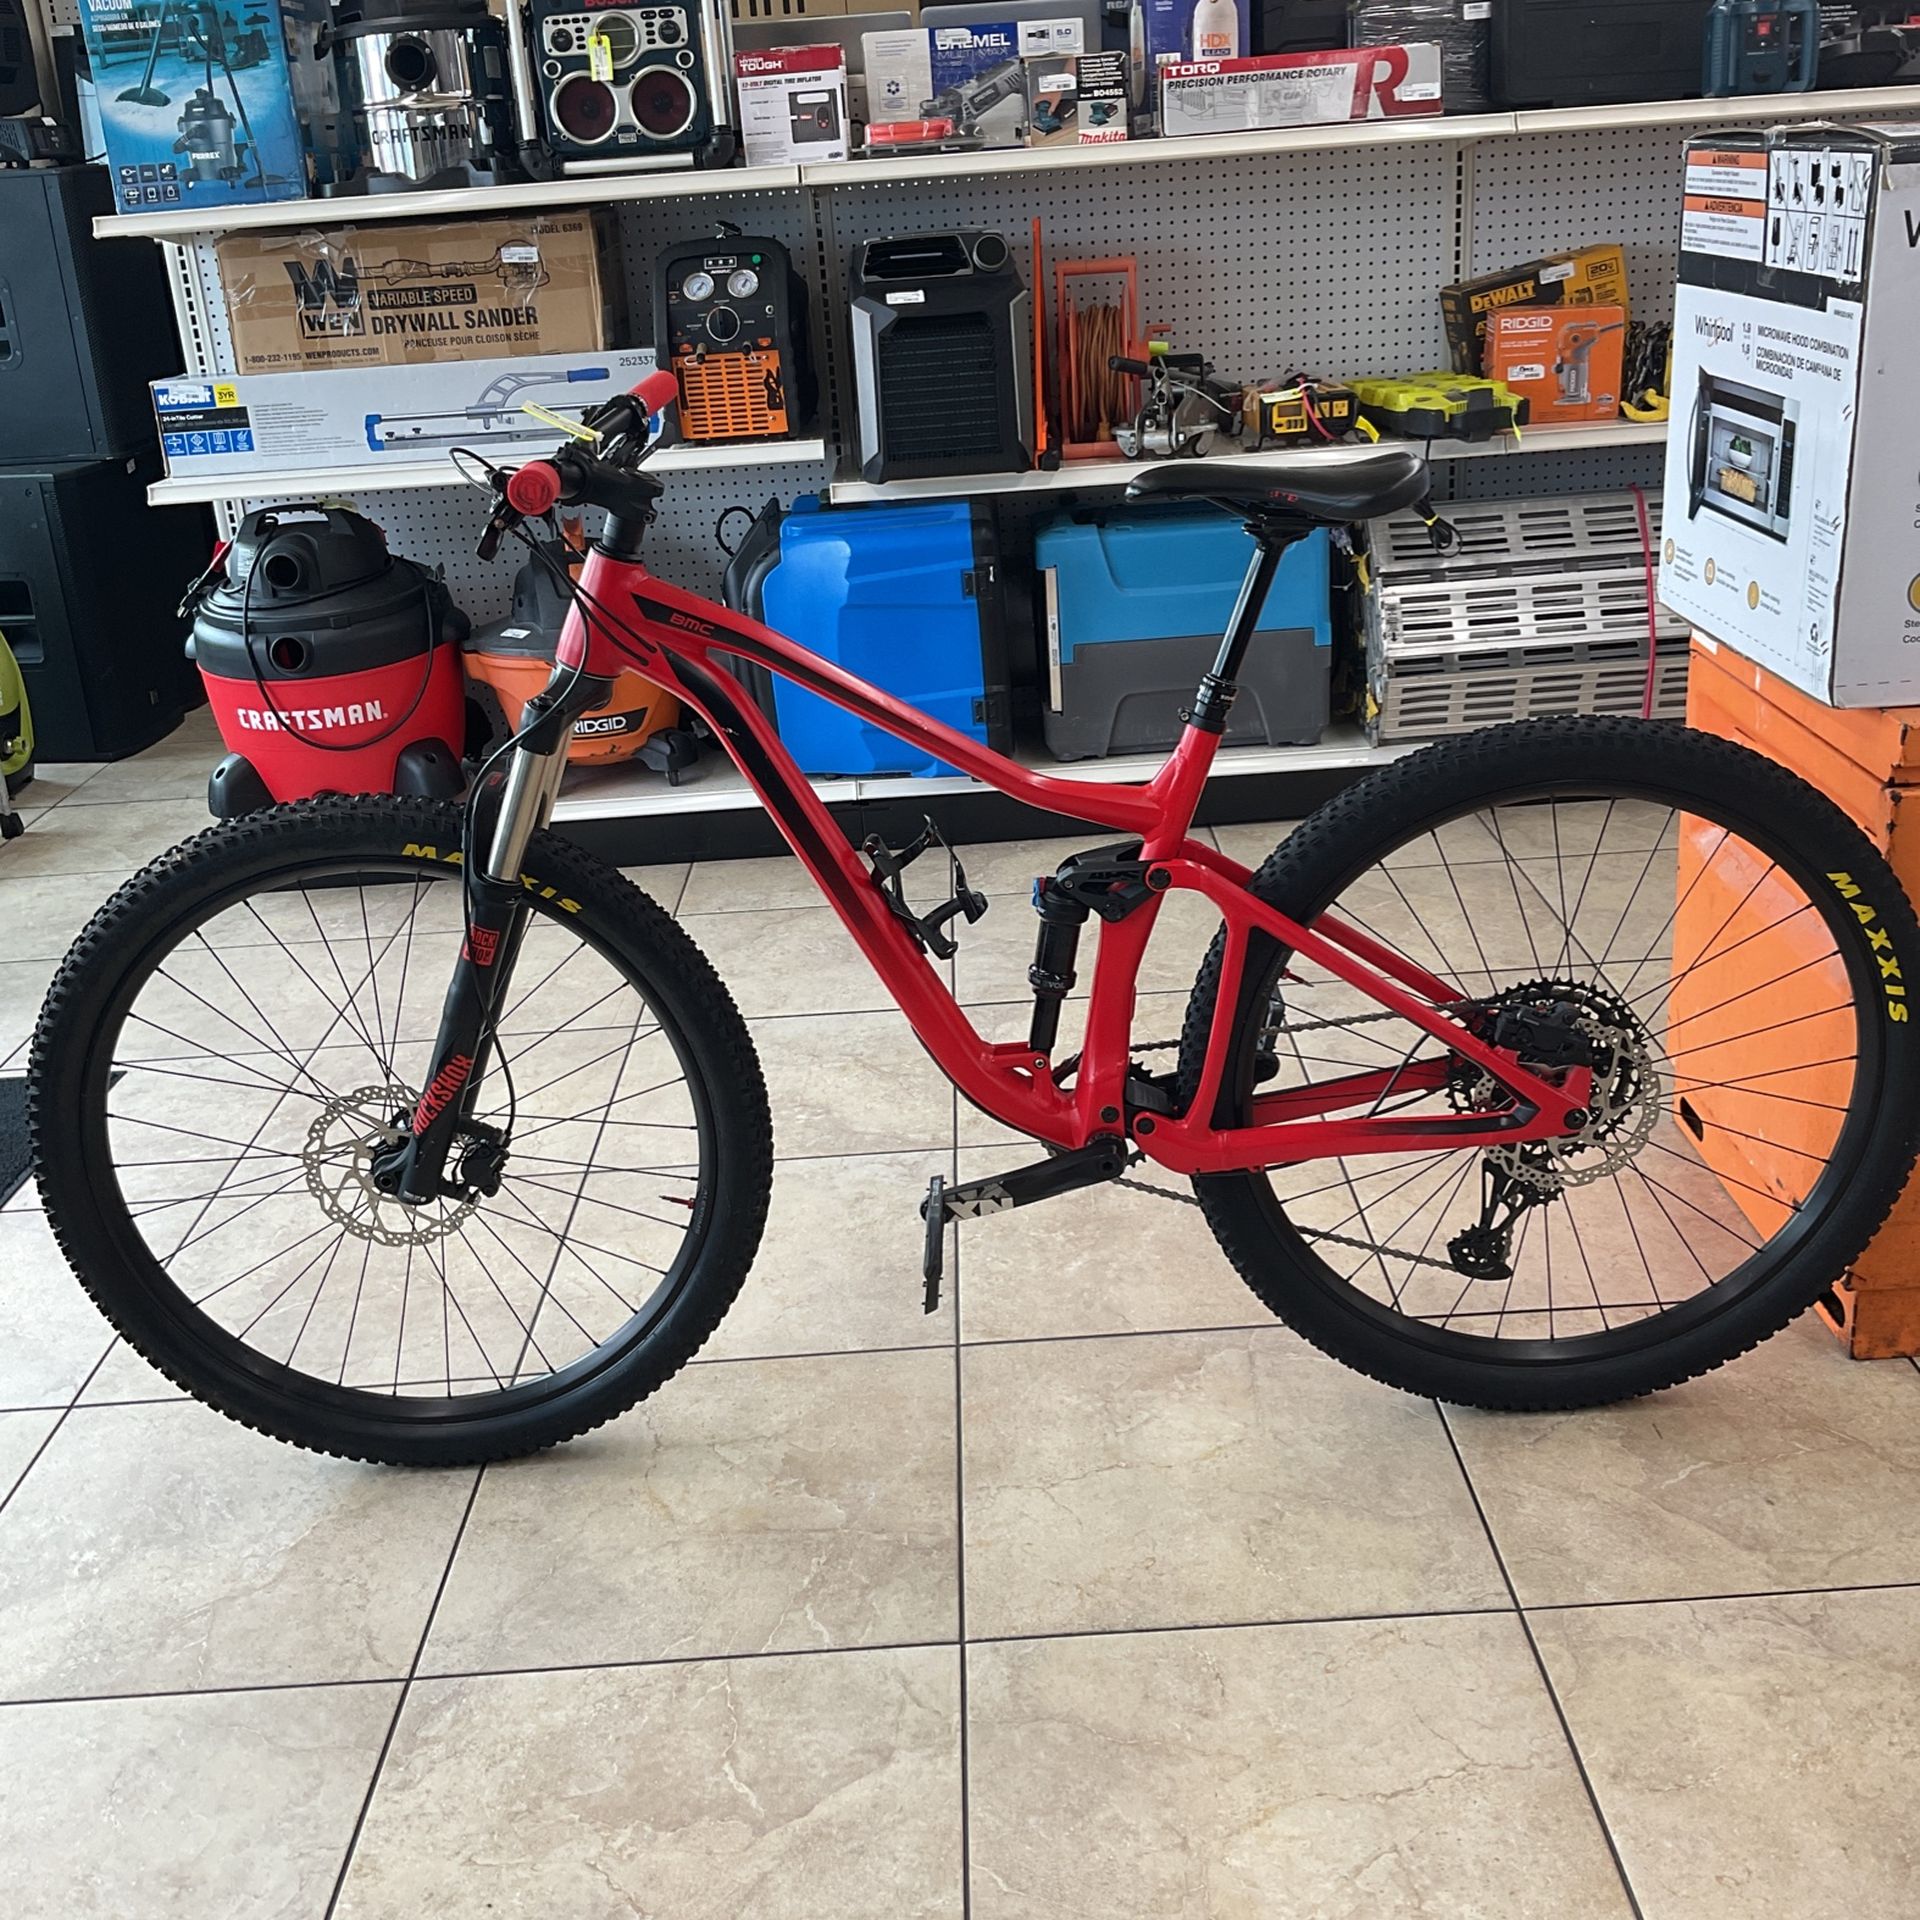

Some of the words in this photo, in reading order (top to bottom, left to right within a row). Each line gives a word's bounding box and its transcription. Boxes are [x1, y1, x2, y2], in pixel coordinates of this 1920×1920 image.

[88, 0, 133, 12] VACUUM
[1200, 33, 1231, 48] HDX
[740, 61, 782, 72] TOUGH
[1168, 62, 1220, 76] TORQ
[763, 78, 783, 86] DIGITAL
[1168, 77, 1224, 90] PRECISION
[1227, 70, 1303, 85] PERFORMANCE
[1303, 65, 1348, 78] ROTARY
[371, 124, 470, 145] CRAFTSMAN
[1079, 130, 1126, 144] makita
[1715, 154, 1740, 166] WARNING
[1709, 201, 1744, 214] ADVERTENCIA
[371, 290, 431, 306] VARIABLE
[433, 287, 473, 303] SPEED
[304, 311, 361, 333] WEN
[372, 311, 460, 335] DRYWALL
[464, 305, 538, 329] SANDER
[1500, 316, 1553, 330] RIDGID
[1695, 314, 1735, 343] Whirlpool
[450, 335, 474, 346] POUR
[474, 333, 513, 345] CLOISON
[1757, 325, 1792, 344] MICROWAVE
[1791, 332, 1809, 347] HOOD
[1809, 336, 1849, 359] COMBINATION
[304, 347, 380, 360] WENPRODUCTS.COM
[1755, 359, 1793, 380] MICROONDAS
[1796, 356, 1805, 370] DE
[1833, 368, 1842, 381] DE
[218, 390, 236, 401] 3YR
[670, 612, 716, 636] BMC
[237, 700, 383, 732] CRAFTSMAN
[1825, 871, 1909, 1024] MAXXIS
